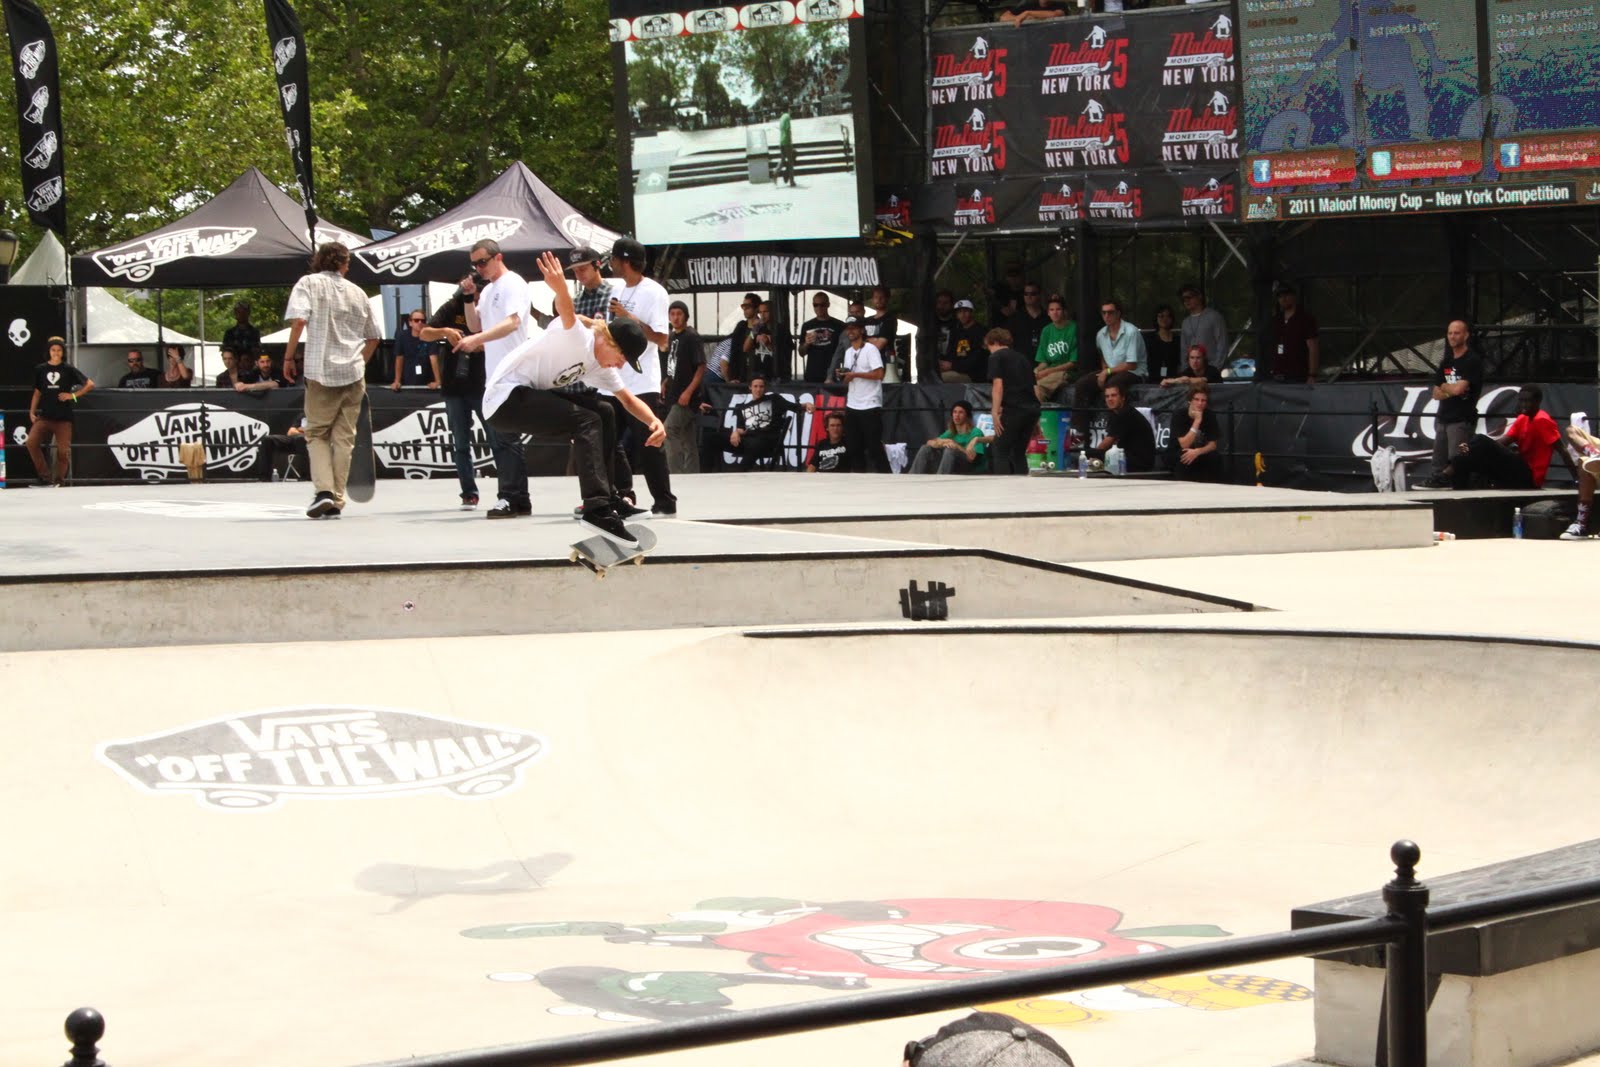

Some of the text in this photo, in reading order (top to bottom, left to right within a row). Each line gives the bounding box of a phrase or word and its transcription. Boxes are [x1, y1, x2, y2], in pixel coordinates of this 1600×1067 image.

[994, 48, 1007, 97] 5
[1048, 38, 1128, 88] Maloof 5
[1041, 74, 1111, 94] NEW YORK
[1162, 68, 1195, 86] NEW
[932, 84, 993, 104] NEW YORK
[1167, 106, 1237, 136] Maloof
[993, 121, 1007, 169] 5
[1048, 112, 1129, 163] Maloof 5
[1045, 149, 1117, 168] NEW YORK
[1162, 142, 1239, 161] NEW YORK
[932, 156, 995, 176] NEW YORK
[1200, 205, 1223, 215] YORK
[1289, 197, 1315, 215] 2011
[1319, 195, 1357, 212] Maloof
[1359, 195, 1397, 212] Money
[1400, 192, 1423, 211] Cup
[1436, 190, 1462, 206] New
[1465, 188, 1493, 205] York
[1496, 185, 1570, 205] Competition
[1039, 210, 1079, 221] NEW YORK
[1090, 208, 1133, 218] NEW YORK
[150, 240, 191, 259] THE
[688, 256, 738, 286] FIVEBORO
[789, 256, 818, 286] CITY
[820, 256, 880, 287] FIVEBORO
[154, 411, 211, 437] VANS
[225, 711, 390, 753] VANS
[259, 744, 384, 787] THE
